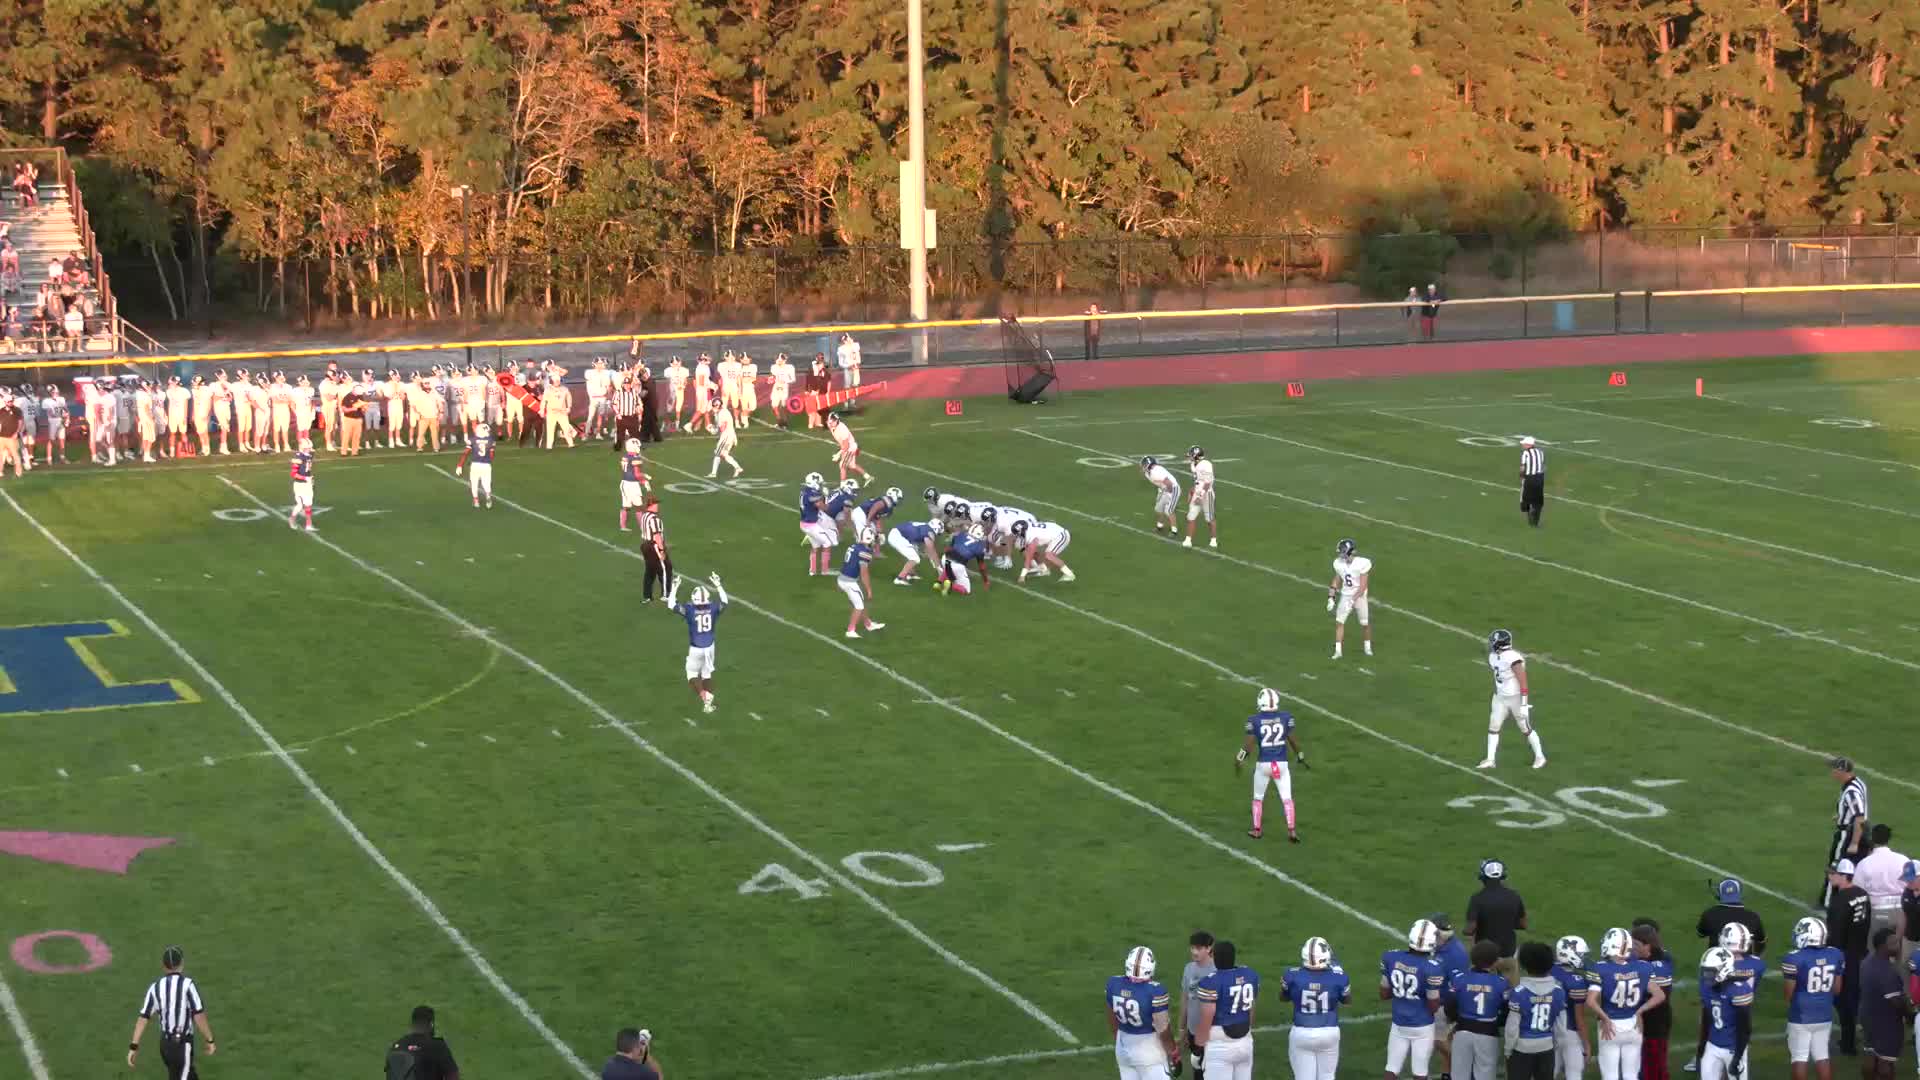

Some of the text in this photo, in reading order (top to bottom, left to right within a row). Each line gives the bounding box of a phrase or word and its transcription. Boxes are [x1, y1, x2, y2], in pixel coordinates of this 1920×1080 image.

[1344, 573, 1353, 588] 6
[694, 613, 712, 633] 19
[1260, 722, 1286, 748] 22
[1446, 786, 1668, 828] 30
[738, 850, 944, 899] 40
[1391, 969, 1420, 1000] 92
[1610, 977, 1641, 1009] 45
[1807, 964, 1836, 993] 65
[1111, 995, 1143, 1027] 53
[1229, 983, 1254, 1014] 79
[1301, 989, 1329, 1014] 51
[1473, 992, 1485, 1016] 1
[1530, 1003, 1551, 1032] 18
